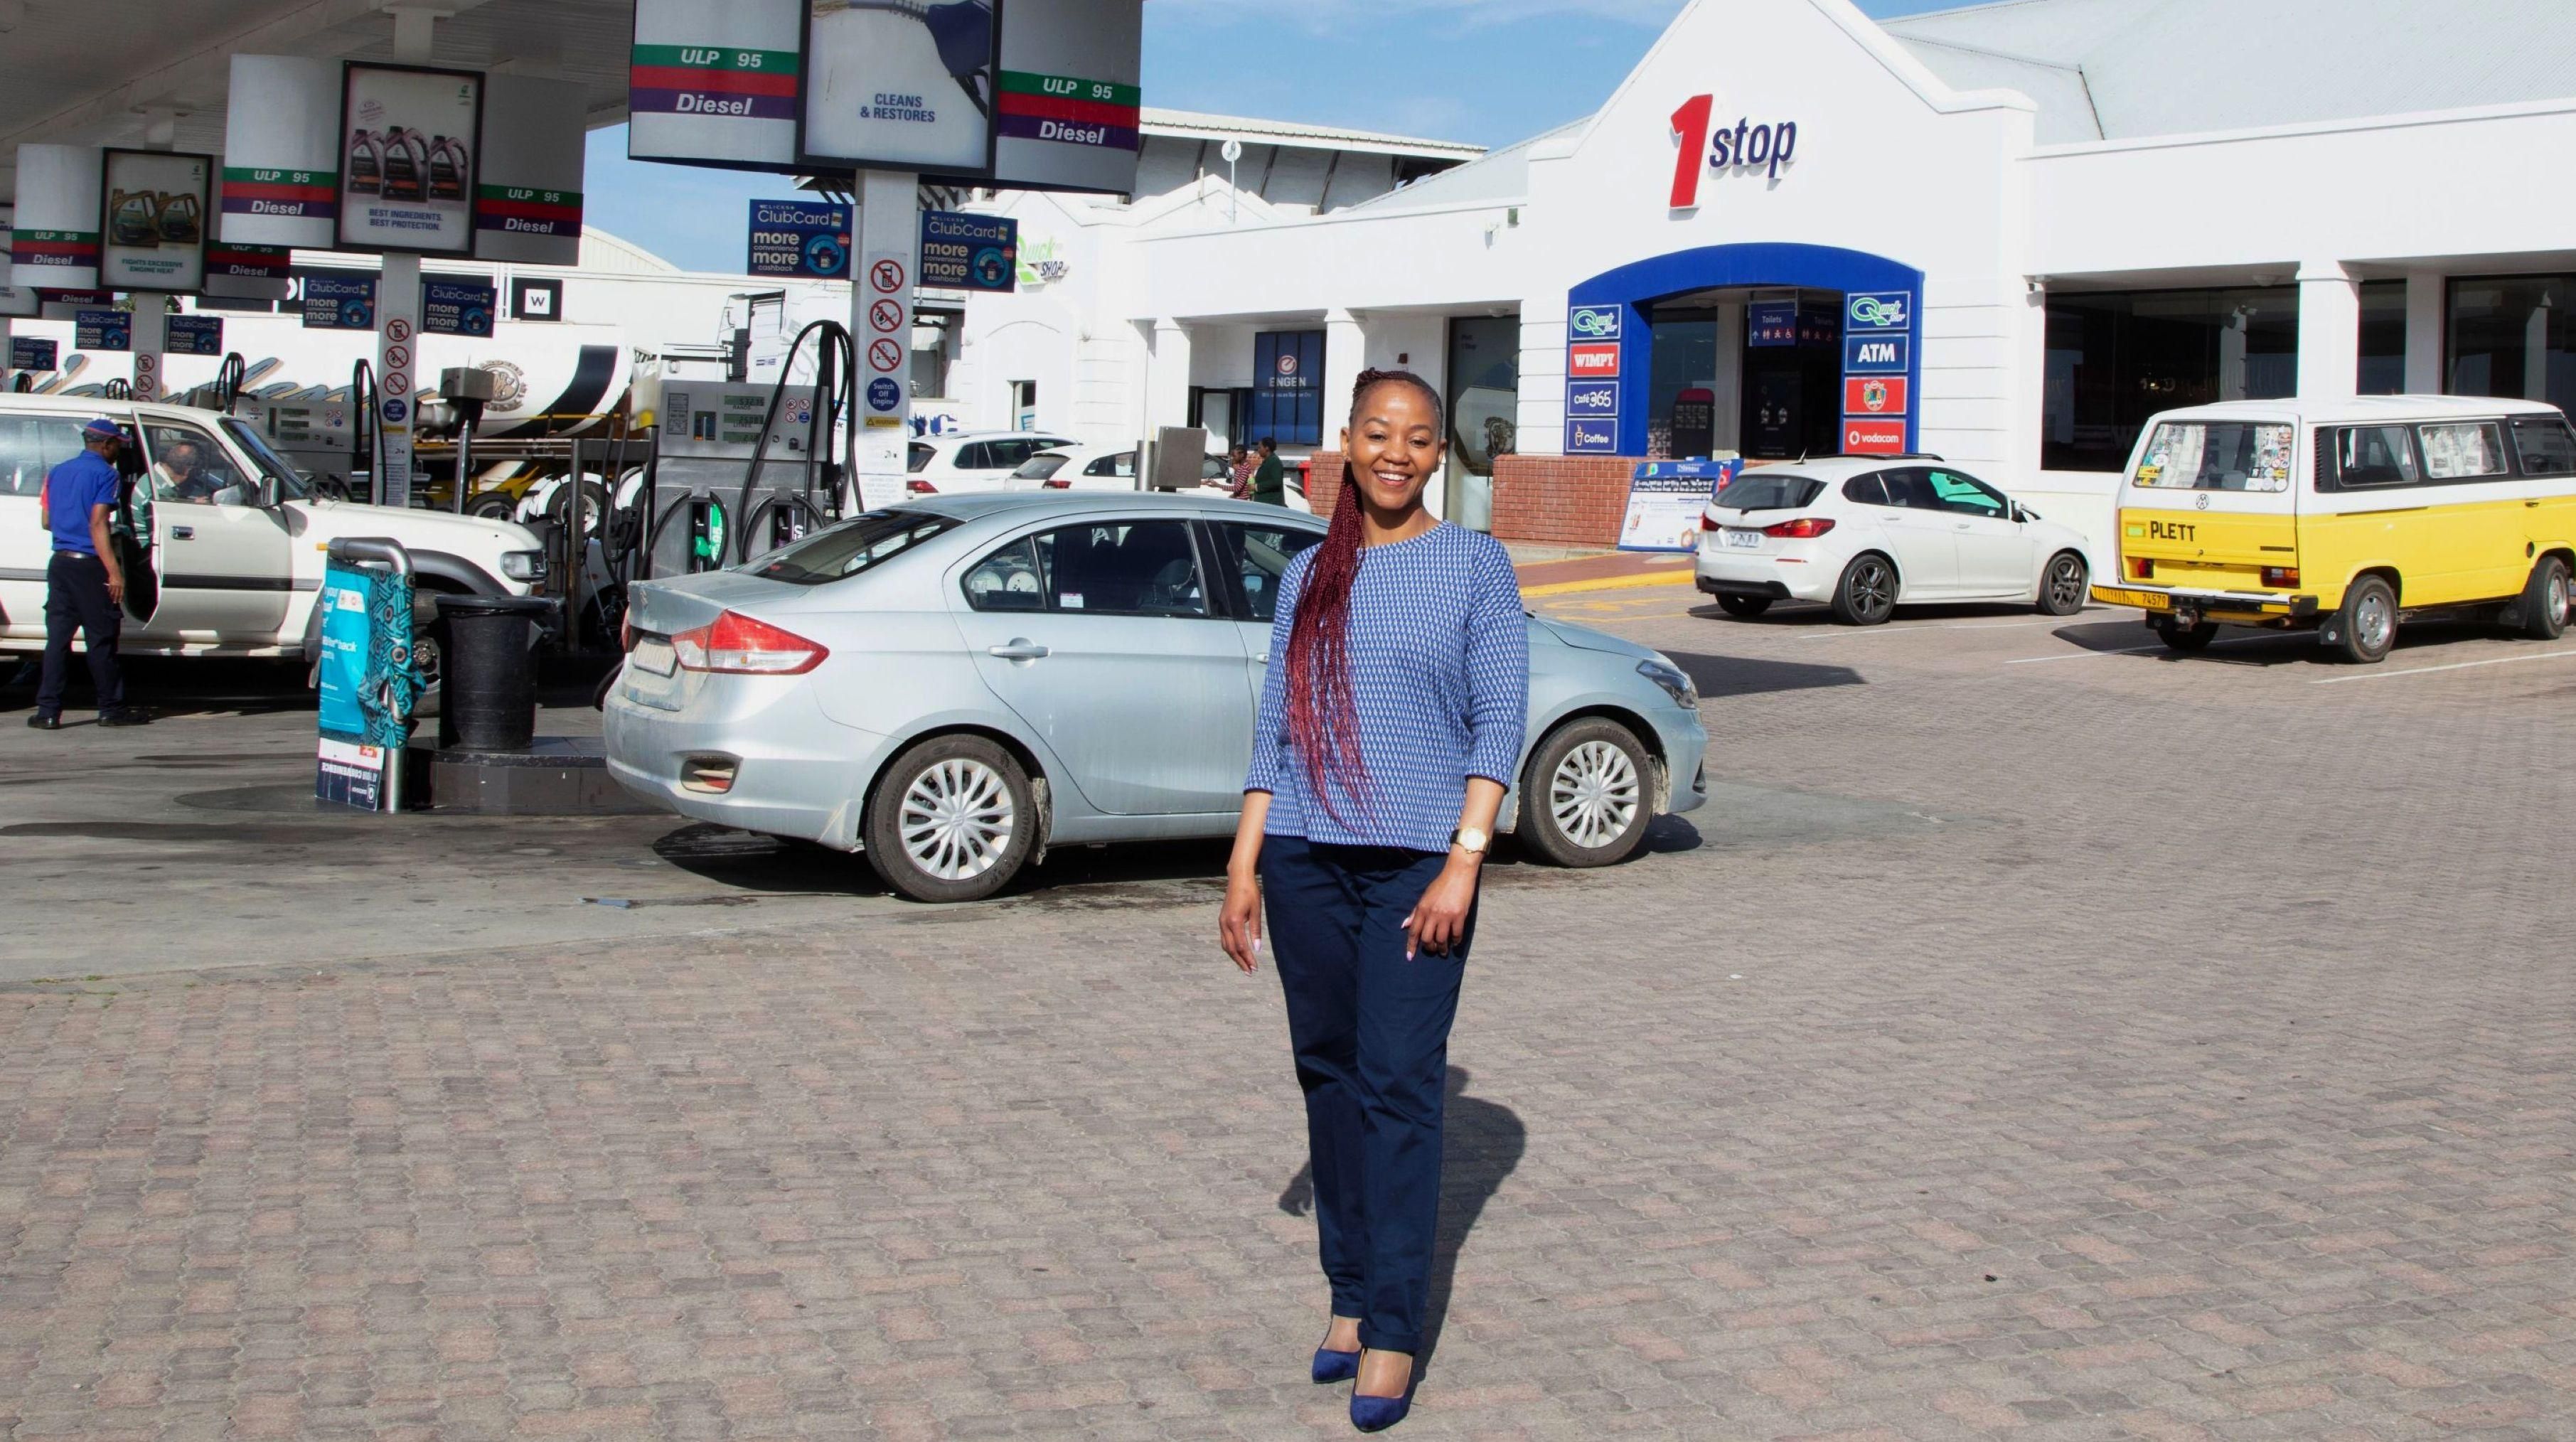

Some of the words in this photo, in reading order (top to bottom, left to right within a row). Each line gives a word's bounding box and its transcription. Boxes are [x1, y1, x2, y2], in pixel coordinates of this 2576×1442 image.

[680, 50, 720, 65] ULP
[737, 53, 762, 68] 95
[1043, 78, 1077, 95] ULP
[1092, 83, 1112, 99] 95
[676, 93, 752, 115] Diesel
[874, 92, 923, 109] CLEANS
[860, 106, 870, 119] &
[873, 107, 936, 123] RESTORES
[1040, 121, 1106, 144] Diesel
[1670, 94, 1714, 208] 1
[1709, 117, 1797, 178] stop
[255, 171, 281, 182] ULP
[292, 172, 310, 183] 95
[508, 188, 533, 200] ULP
[544, 192, 560, 203] 95
[251, 201, 304, 215] Diesel
[368, 208, 388, 218] BEST
[370, 218, 389, 228] BEST
[757, 210, 829, 225] ClubCard
[505, 218, 555, 233] Diesel
[929, 221, 995, 239] ClubCard
[753, 232, 800, 245] more
[924, 243, 968, 256] more
[33, 255, 74, 265] Diesel
[753, 252, 800, 265] more
[230, 265, 269, 276] Diesel
[924, 262, 968, 276] more
[1040, 261, 1063, 277] SHOP
[309, 284, 359, 294] ClubCard
[432, 289, 480, 301] ClubCard
[61, 294, 94, 304] Diesel
[306, 299, 338, 307] more
[530, 296, 545, 306] W
[427, 304, 460, 314] more
[306, 312, 338, 321] more
[427, 317, 459, 327] more
[1858, 343, 1896, 362] ATM
[1574, 353, 1615, 368] WIMPY
[1268, 377, 1307, 387] ENGEN
[1589, 390, 1611, 407] 365
[1584, 434, 1609, 444] Coffee
[1861, 434, 1899, 444] vodacom
[2150, 520, 2196, 542] PLETT
[2142, 594, 2166, 606] 74579
